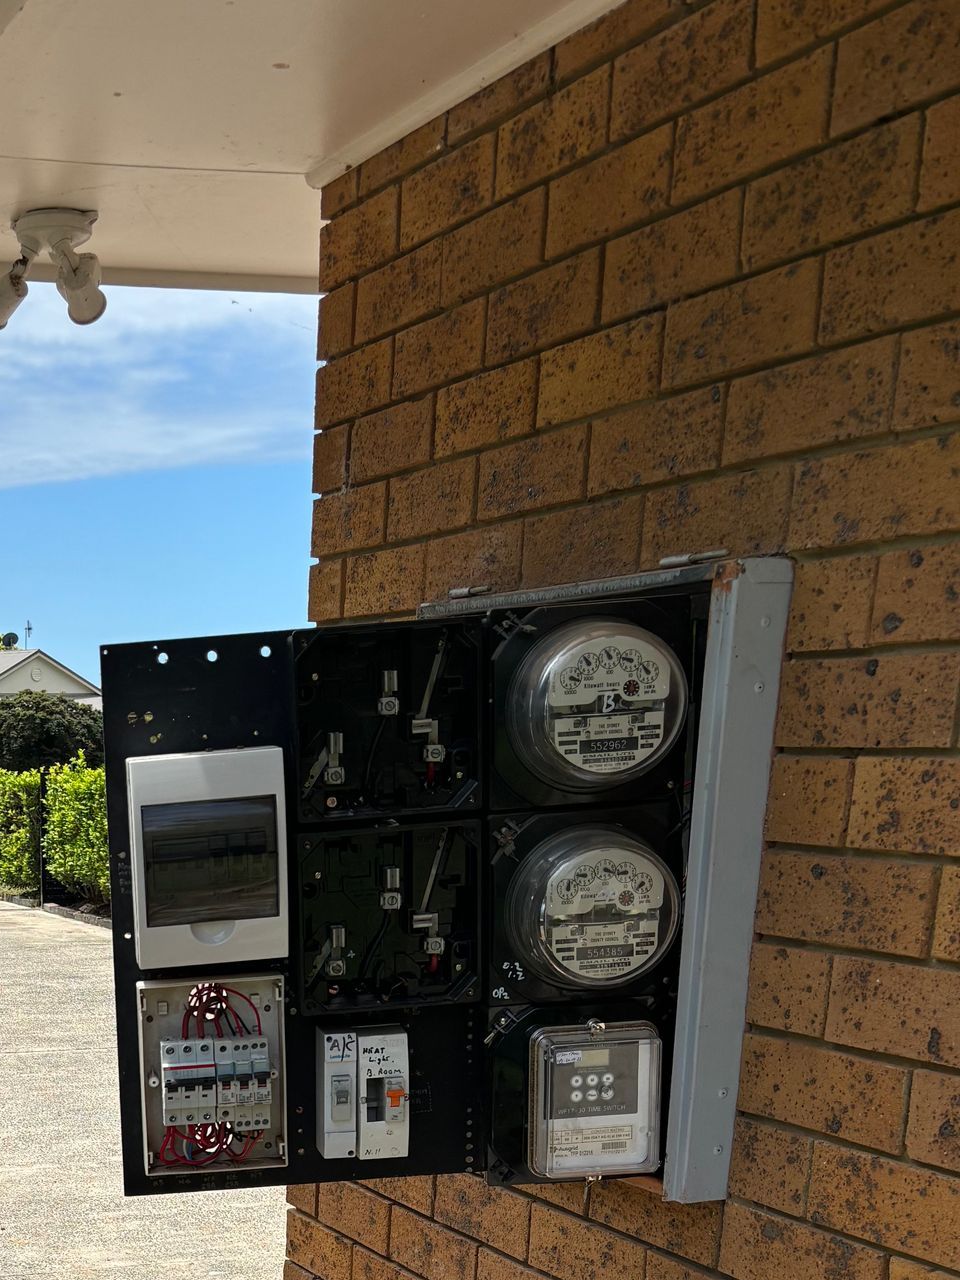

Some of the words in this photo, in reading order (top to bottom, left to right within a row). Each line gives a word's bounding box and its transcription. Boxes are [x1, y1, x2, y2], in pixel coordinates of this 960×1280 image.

[590, 740, 627, 751] 552962
[587, 946, 623, 958] 554385
[603, 1104, 626, 1112] SWITCH
